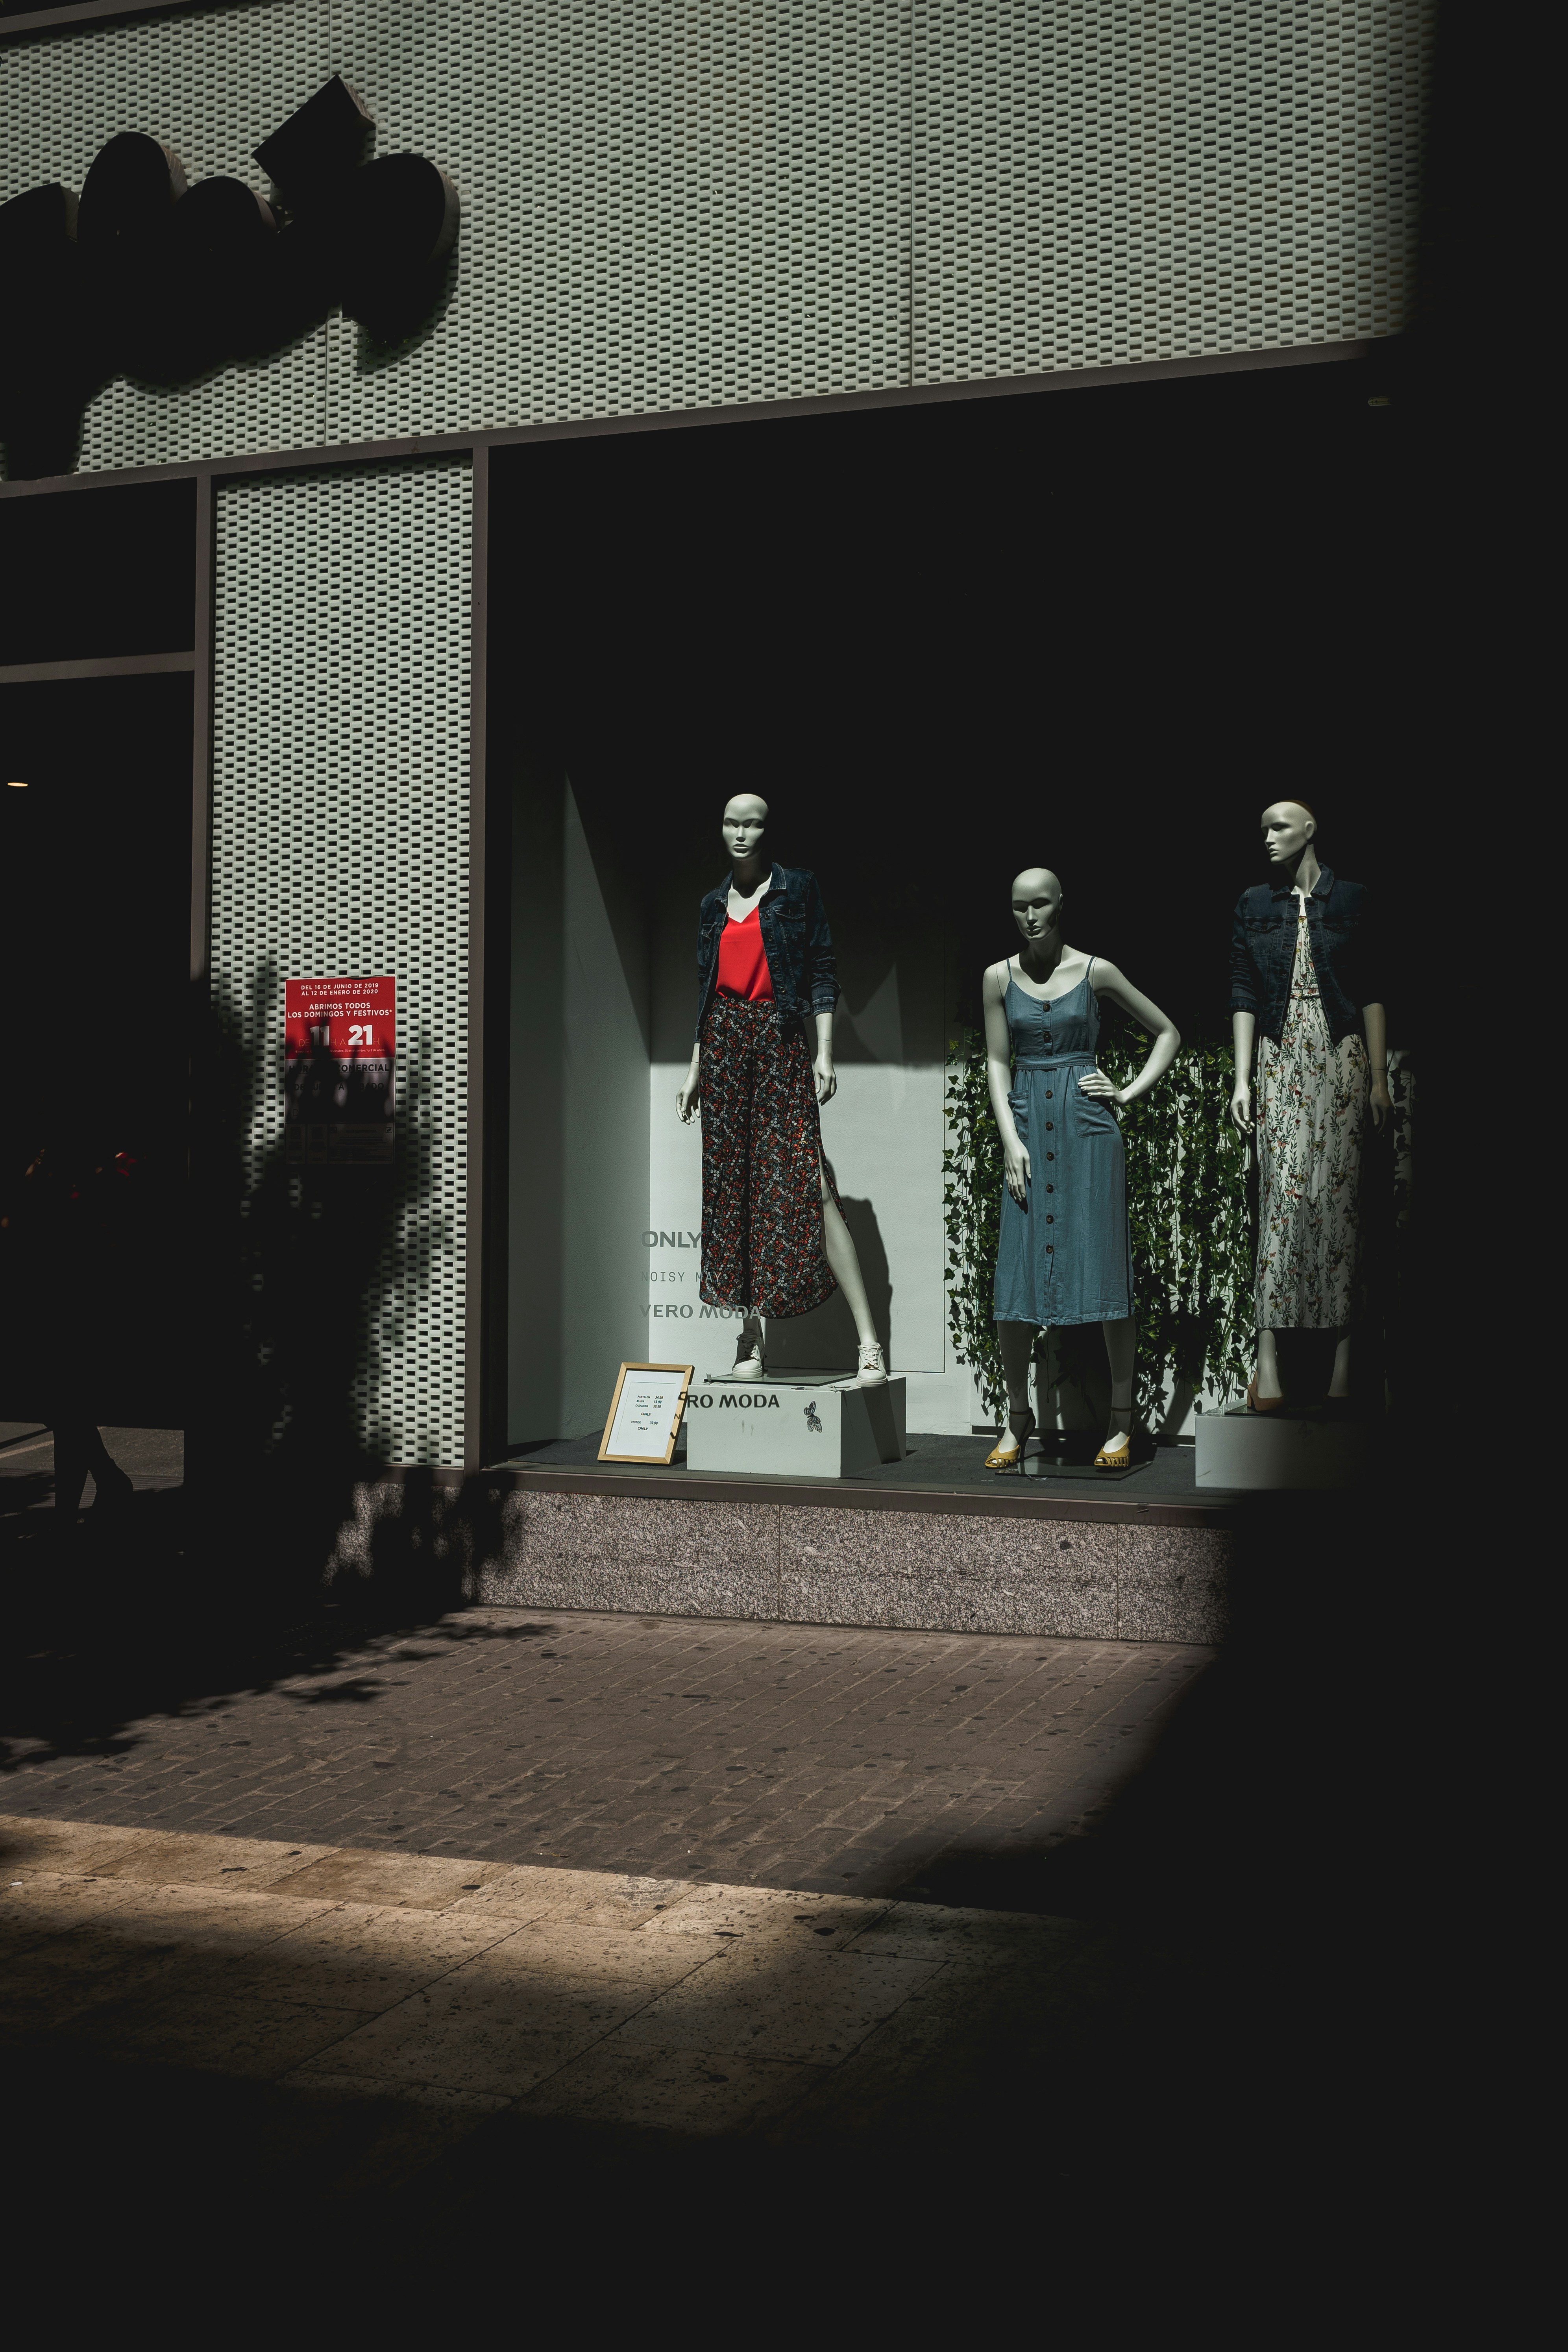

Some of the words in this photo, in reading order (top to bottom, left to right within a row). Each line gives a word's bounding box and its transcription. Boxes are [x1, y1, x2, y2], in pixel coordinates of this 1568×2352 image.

[310, 1026, 330, 1046] 11
[348, 1025, 373, 1045] 21
[337, 1064, 390, 1072] COMERCIAL
[641, 1231, 703, 1248] ONLY
[641, 1272, 685, 1282] NOISY
[696, 1272, 721, 1282] MAY
[640, 1304, 693, 1318] VERO
[699, 1305, 762, 1319] MODA
[719, 1394, 780, 1408] MODA
